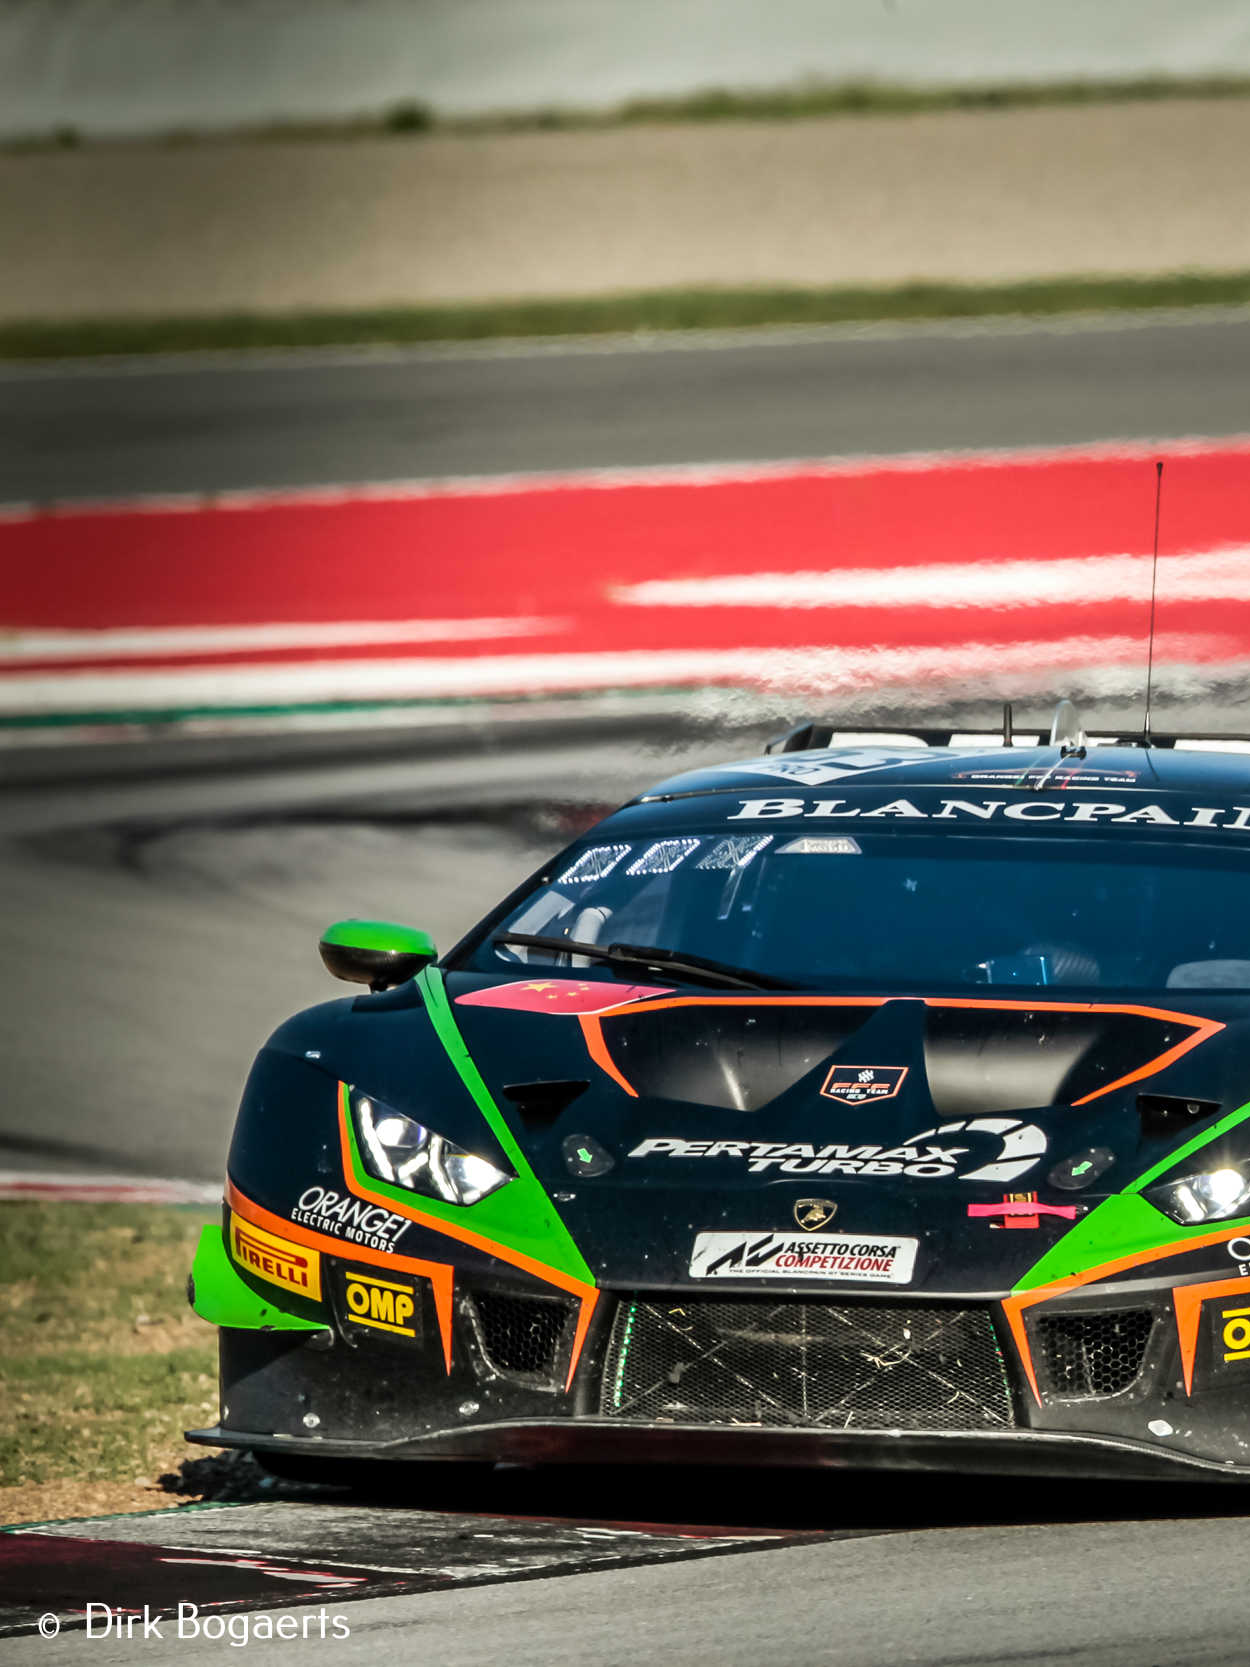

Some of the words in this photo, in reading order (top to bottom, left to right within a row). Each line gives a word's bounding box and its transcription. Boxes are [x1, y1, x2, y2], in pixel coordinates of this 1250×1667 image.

[627, 1138, 969, 1164] PERTAMAX
[748, 1158, 956, 1177] TURBO
[291, 1207, 342, 1236] ELECTRIC
[345, 1225, 396, 1255] MOTORS
[298, 1186, 412, 1242] ORANGE1
[235, 1226, 309, 1288] PIRELLI
[775, 1255, 894, 1272] COMPETIZIONE
[785, 1242, 850, 1256] ASSETTO
[850, 1244, 898, 1258] CORSA
[346, 1283, 415, 1326] OMP
